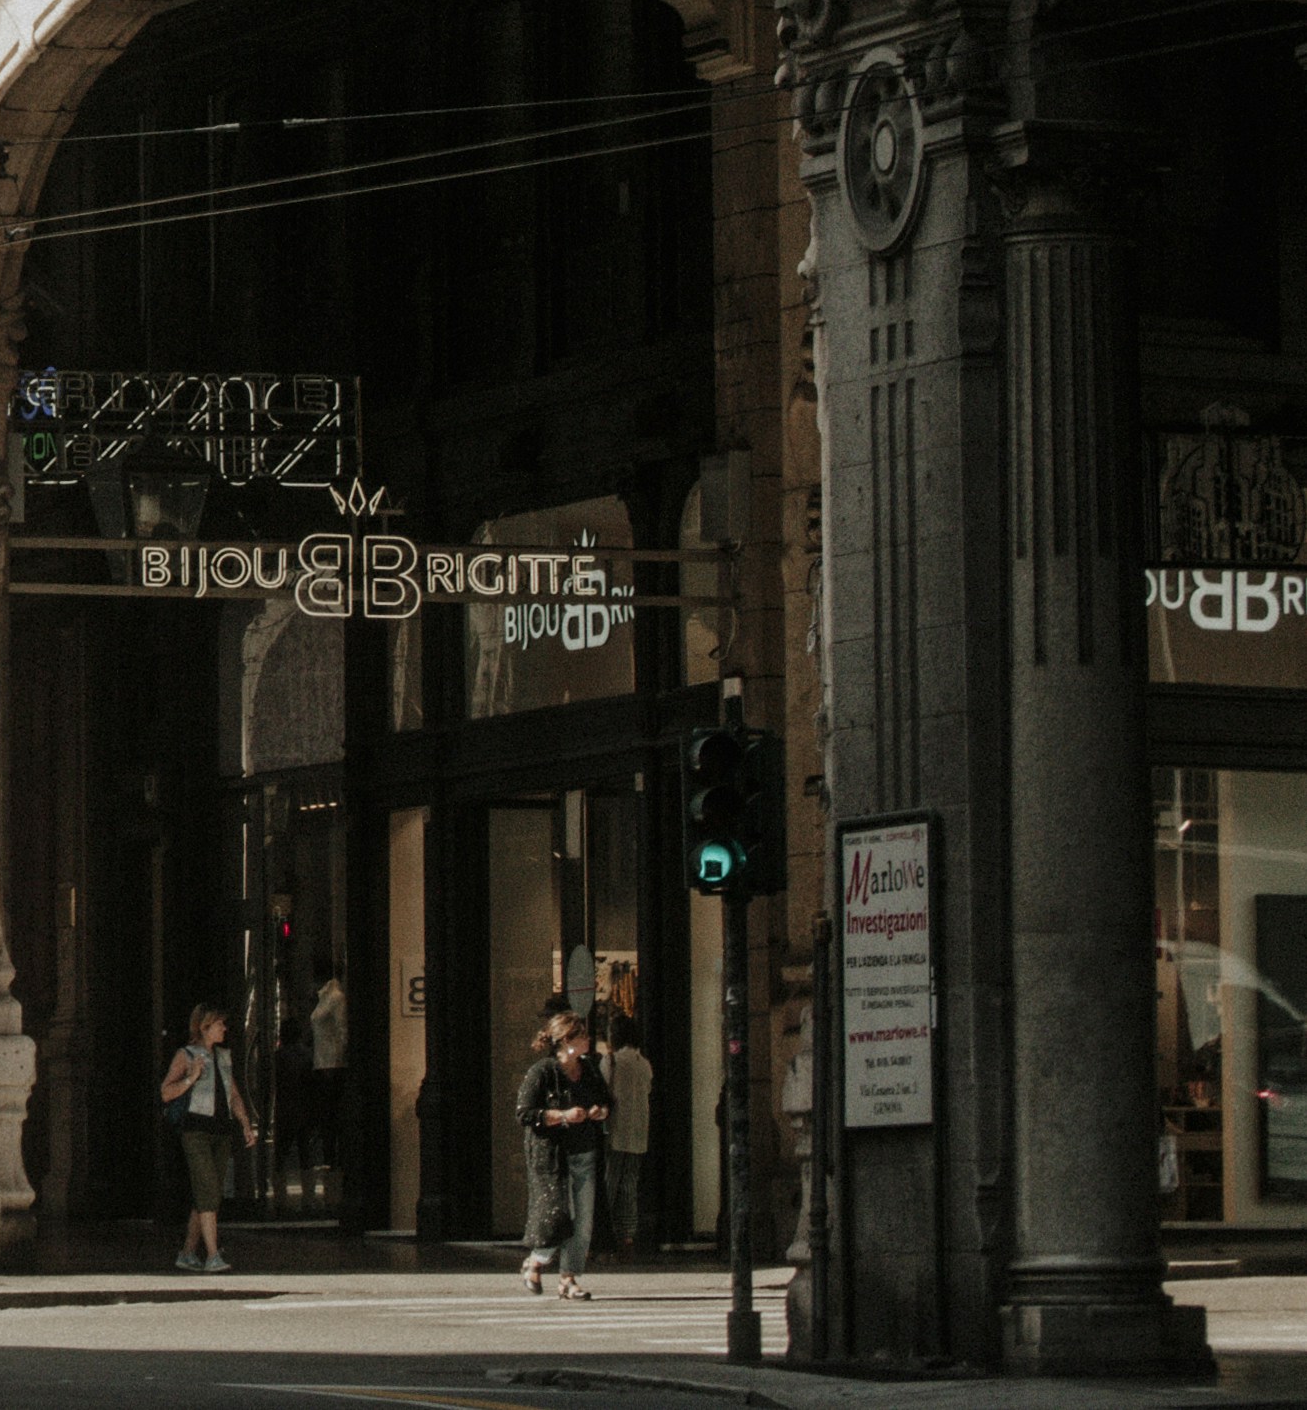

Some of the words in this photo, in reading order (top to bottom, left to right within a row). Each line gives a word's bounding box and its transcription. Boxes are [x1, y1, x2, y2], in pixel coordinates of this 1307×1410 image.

[141, 545, 287, 599] BIJOU
[504, 602, 560, 651] BIJOU
[847, 906, 927, 940] Investigazioni
[848, 1025, 928, 1045] www.marlowe.it
